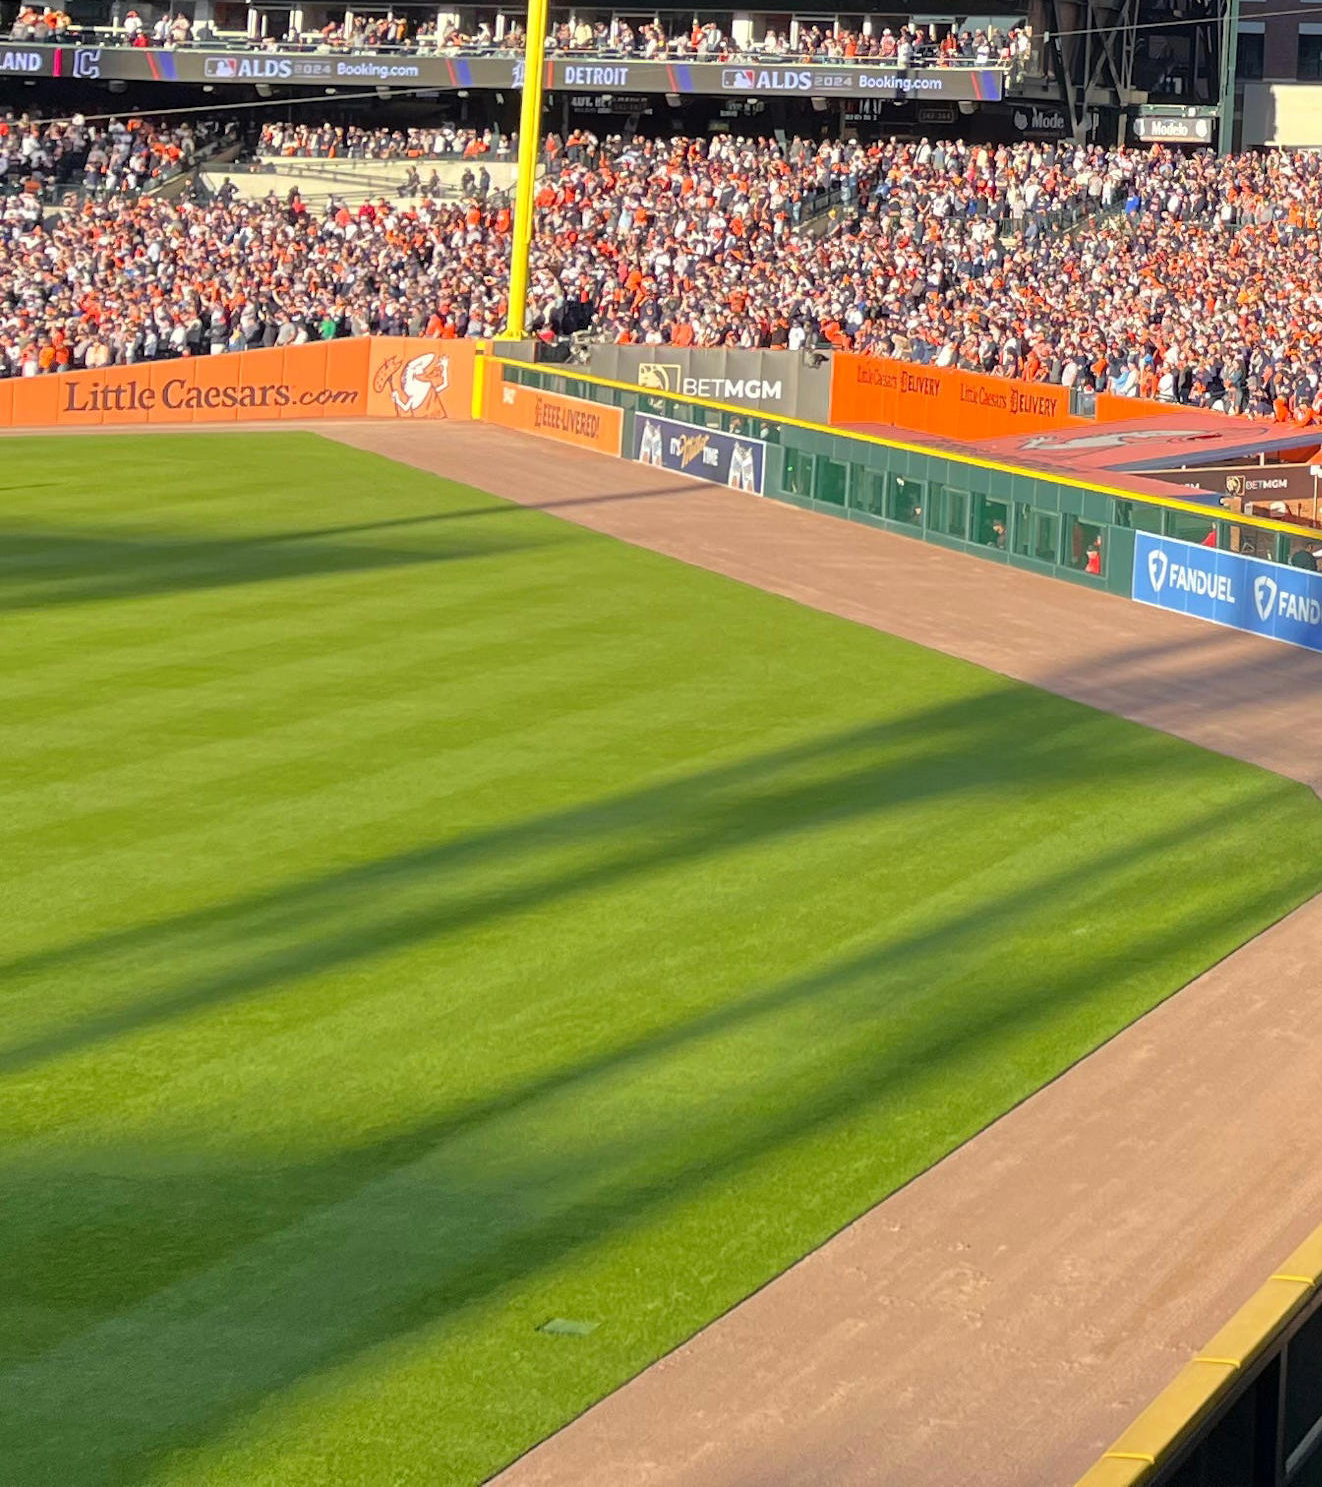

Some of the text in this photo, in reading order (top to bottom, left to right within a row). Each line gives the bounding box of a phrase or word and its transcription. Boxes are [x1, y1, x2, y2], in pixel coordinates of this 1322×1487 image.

[0, 51, 43, 72] AND
[237, 59, 419, 80] ALDS 2024 Booking.com
[565, 66, 629, 86] DETROIT
[756, 71, 942, 91] ALDS 2024 Booking.com
[1151, 122, 1189, 137] Modelo
[682, 378, 782, 400] BETMGM
[857, 365, 941, 397] Little Caesars DELIVERY
[64, 377, 360, 413] Little Caesars.com
[959, 383, 1058, 417] Little Caesars DELIVERY
[1245, 478, 1288, 490] BETMGM
[1169, 563, 1236, 604] FANDUEL
